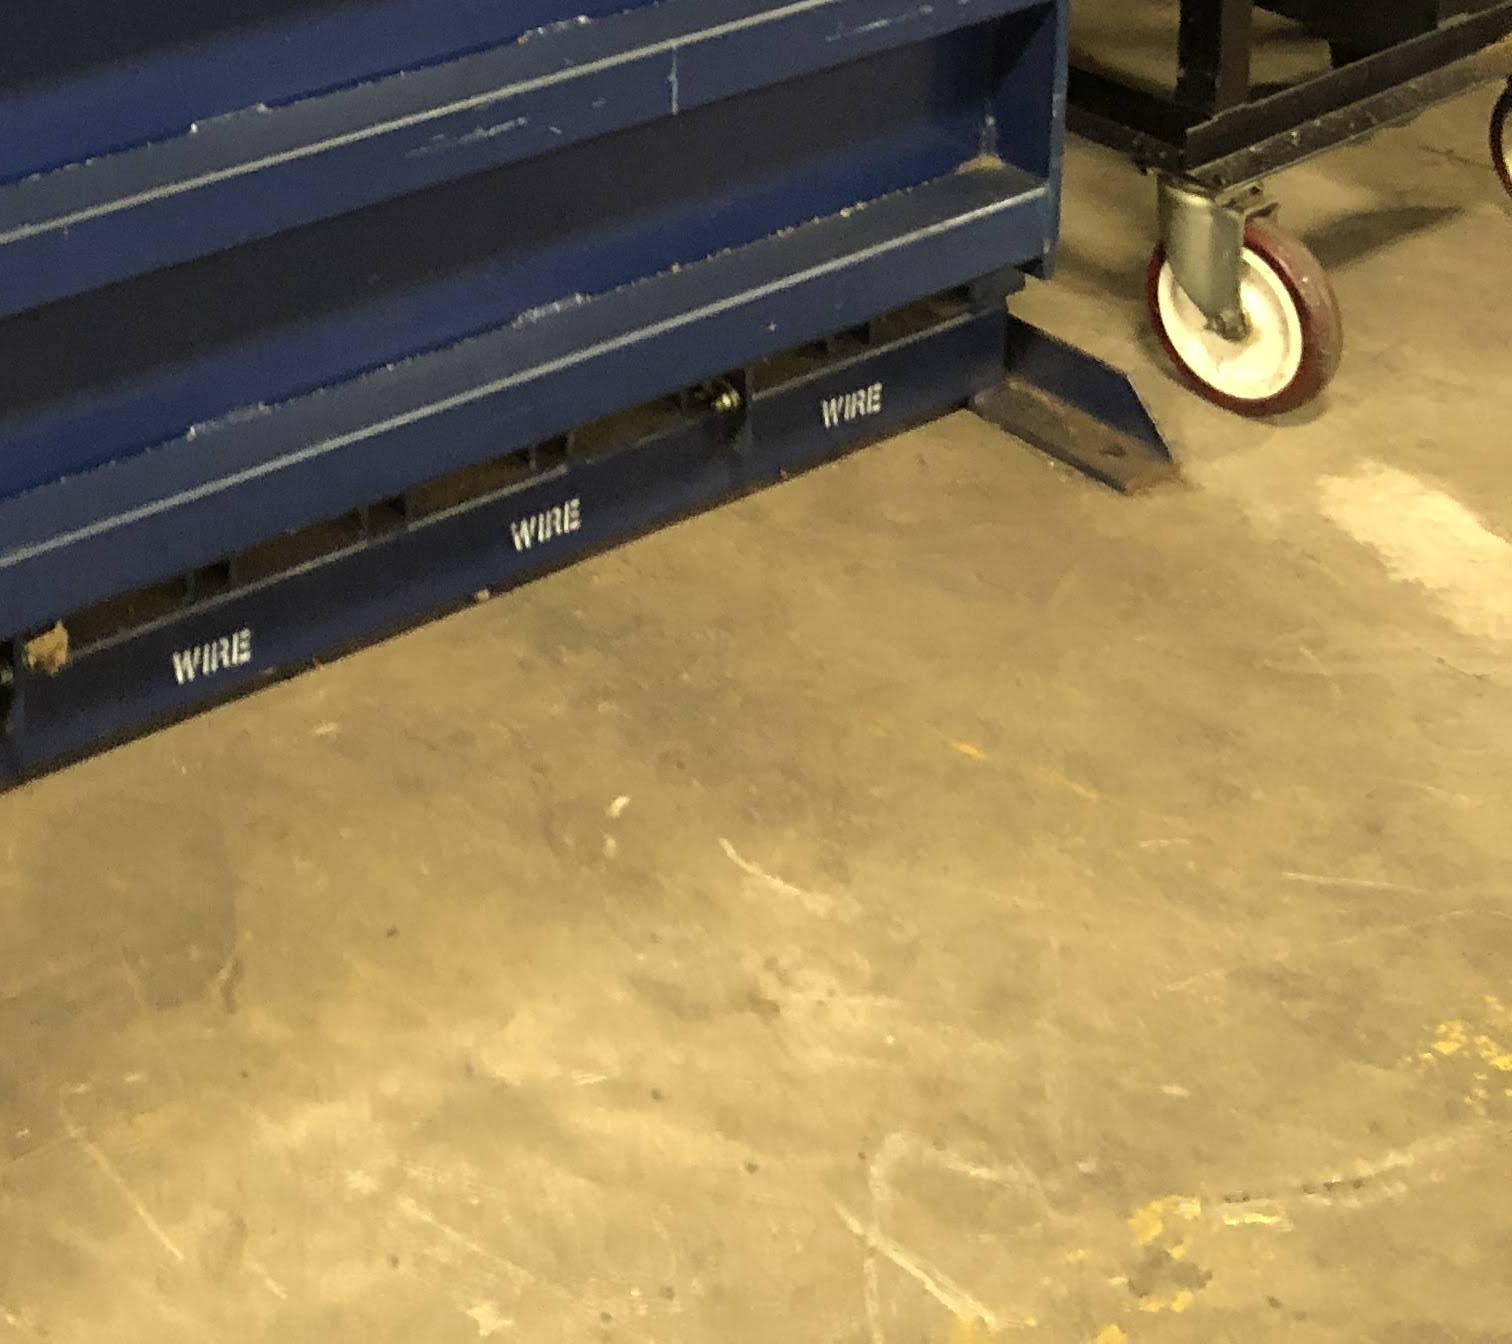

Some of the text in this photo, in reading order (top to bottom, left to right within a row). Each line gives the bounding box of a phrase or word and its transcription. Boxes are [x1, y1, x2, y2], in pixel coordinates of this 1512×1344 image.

[821, 381, 884, 430] WIRE
[511, 497, 582, 553] WIRE
[171, 628, 252, 686] WIRE
